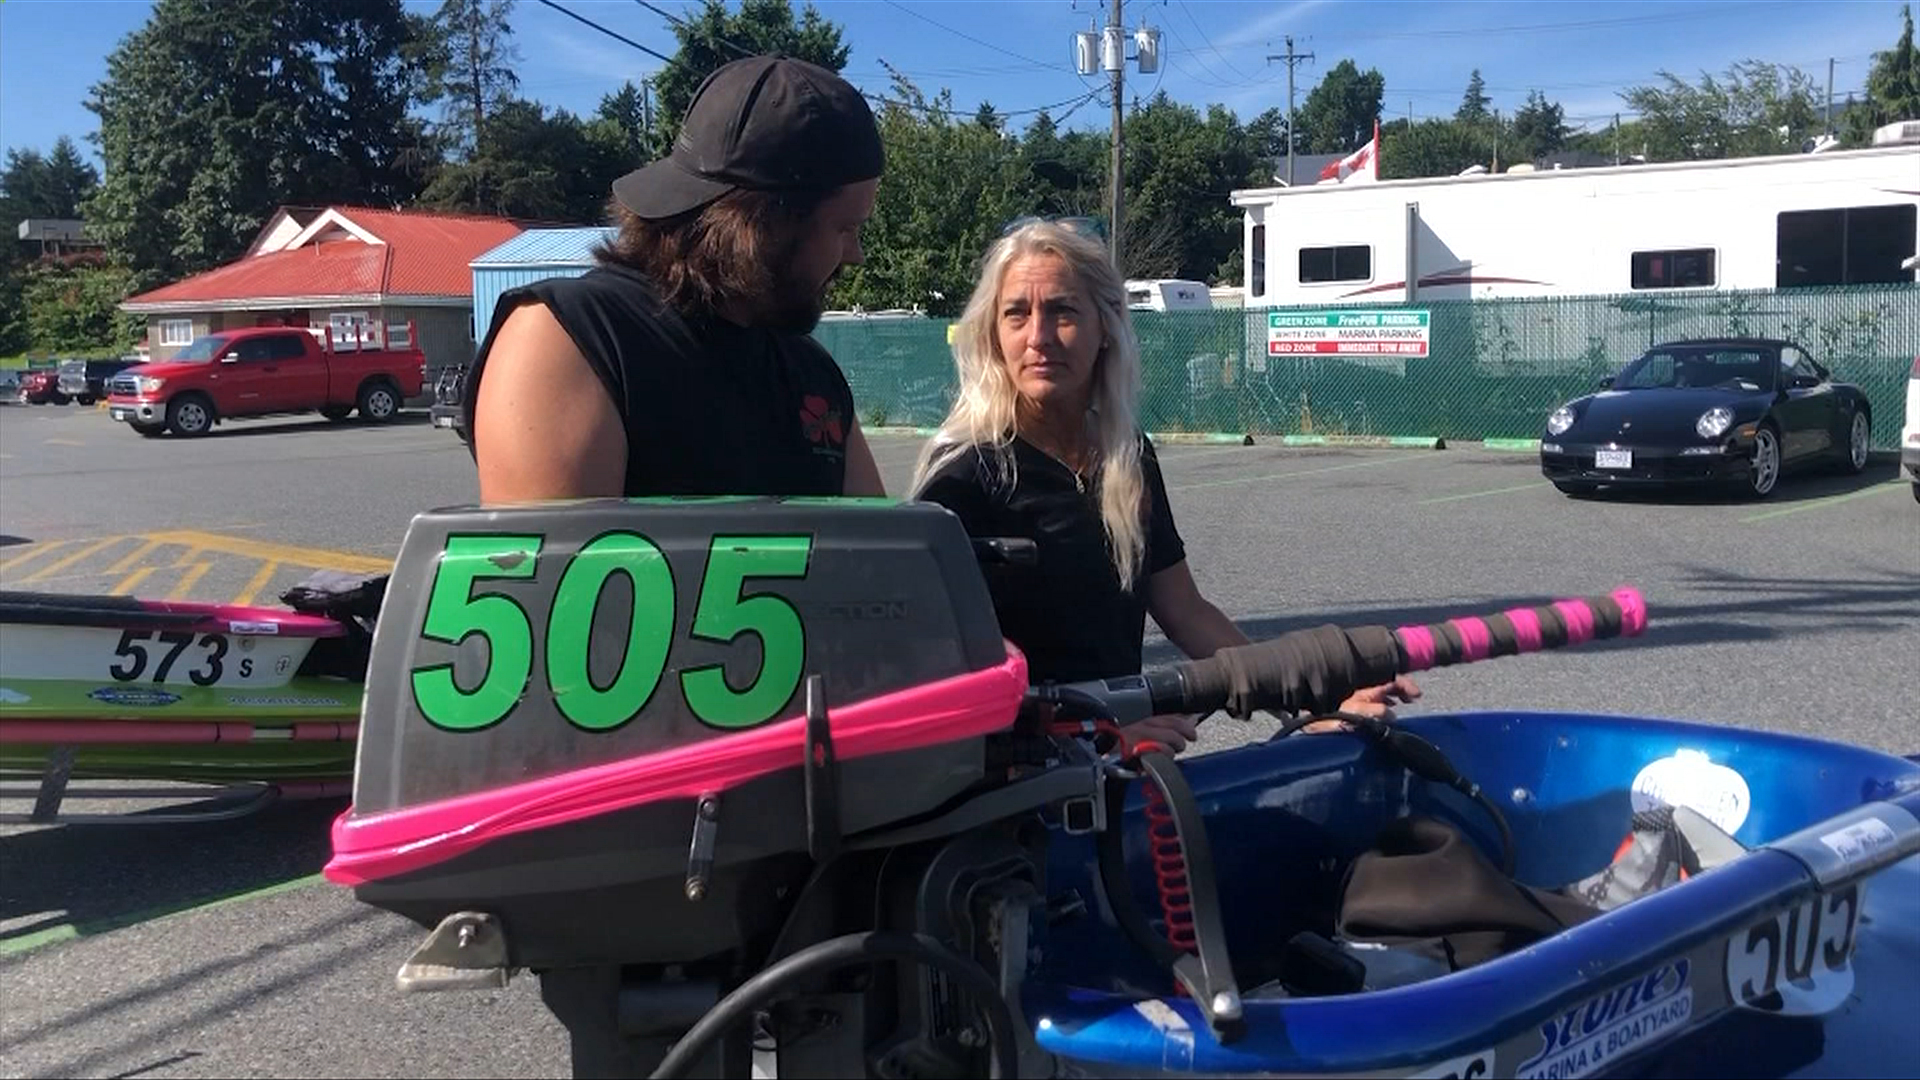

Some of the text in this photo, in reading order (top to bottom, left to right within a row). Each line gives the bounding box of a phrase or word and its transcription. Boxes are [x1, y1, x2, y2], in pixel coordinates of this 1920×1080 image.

[1275, 315, 1327, 326] GREEN ZONE
[1381, 315, 1420, 325] PARKING
[1275, 330, 1327, 338] WHITE ZONE
[1338, 329, 1422, 339] MARINA PARKING
[1274, 343, 1316, 352] RED ZONE
[1337, 343, 1421, 352] IMMEDIATE TOW AWAY
[410, 530, 813, 732] 505
[110, 629, 229, 687] 573
[239, 658, 253, 679] S
[1592, 1041, 1603, 1062] &
[1607, 996, 1690, 1055] BOATYARD
